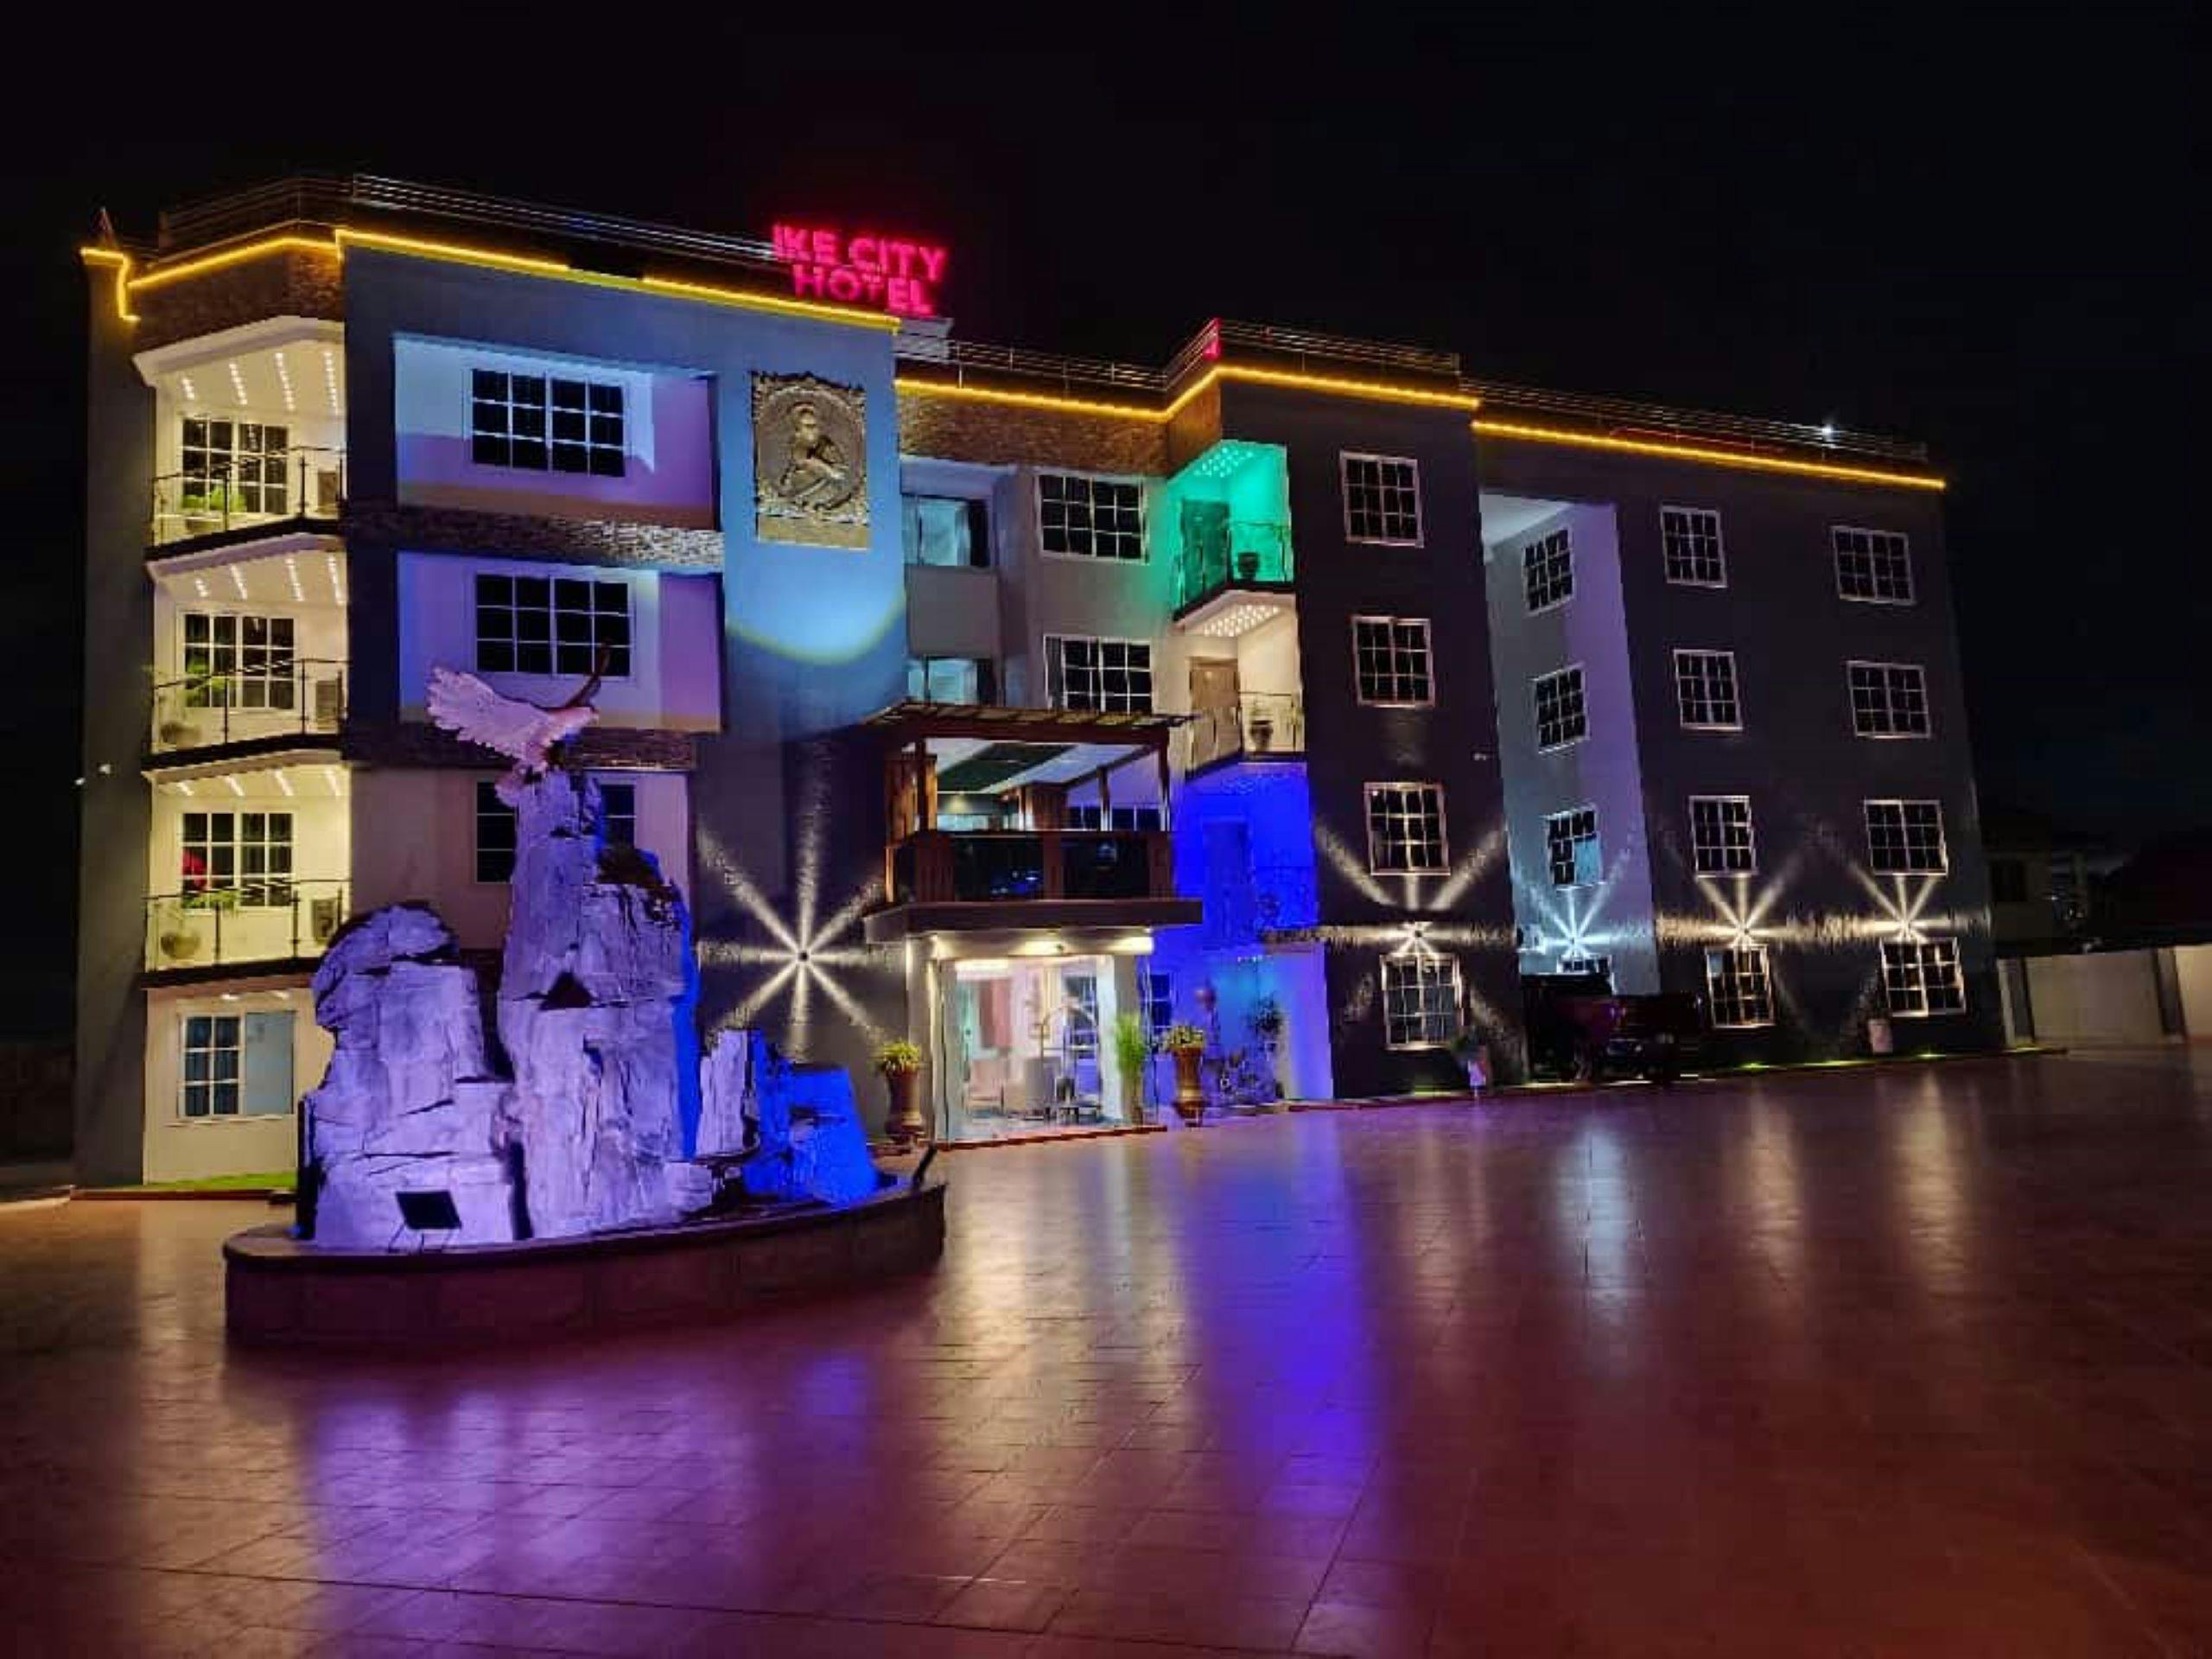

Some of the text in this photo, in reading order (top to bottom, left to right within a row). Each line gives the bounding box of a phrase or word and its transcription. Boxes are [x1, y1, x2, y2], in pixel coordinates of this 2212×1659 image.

[773, 224, 947, 282] IKE CITY
[792, 264, 933, 315] HOTEL
